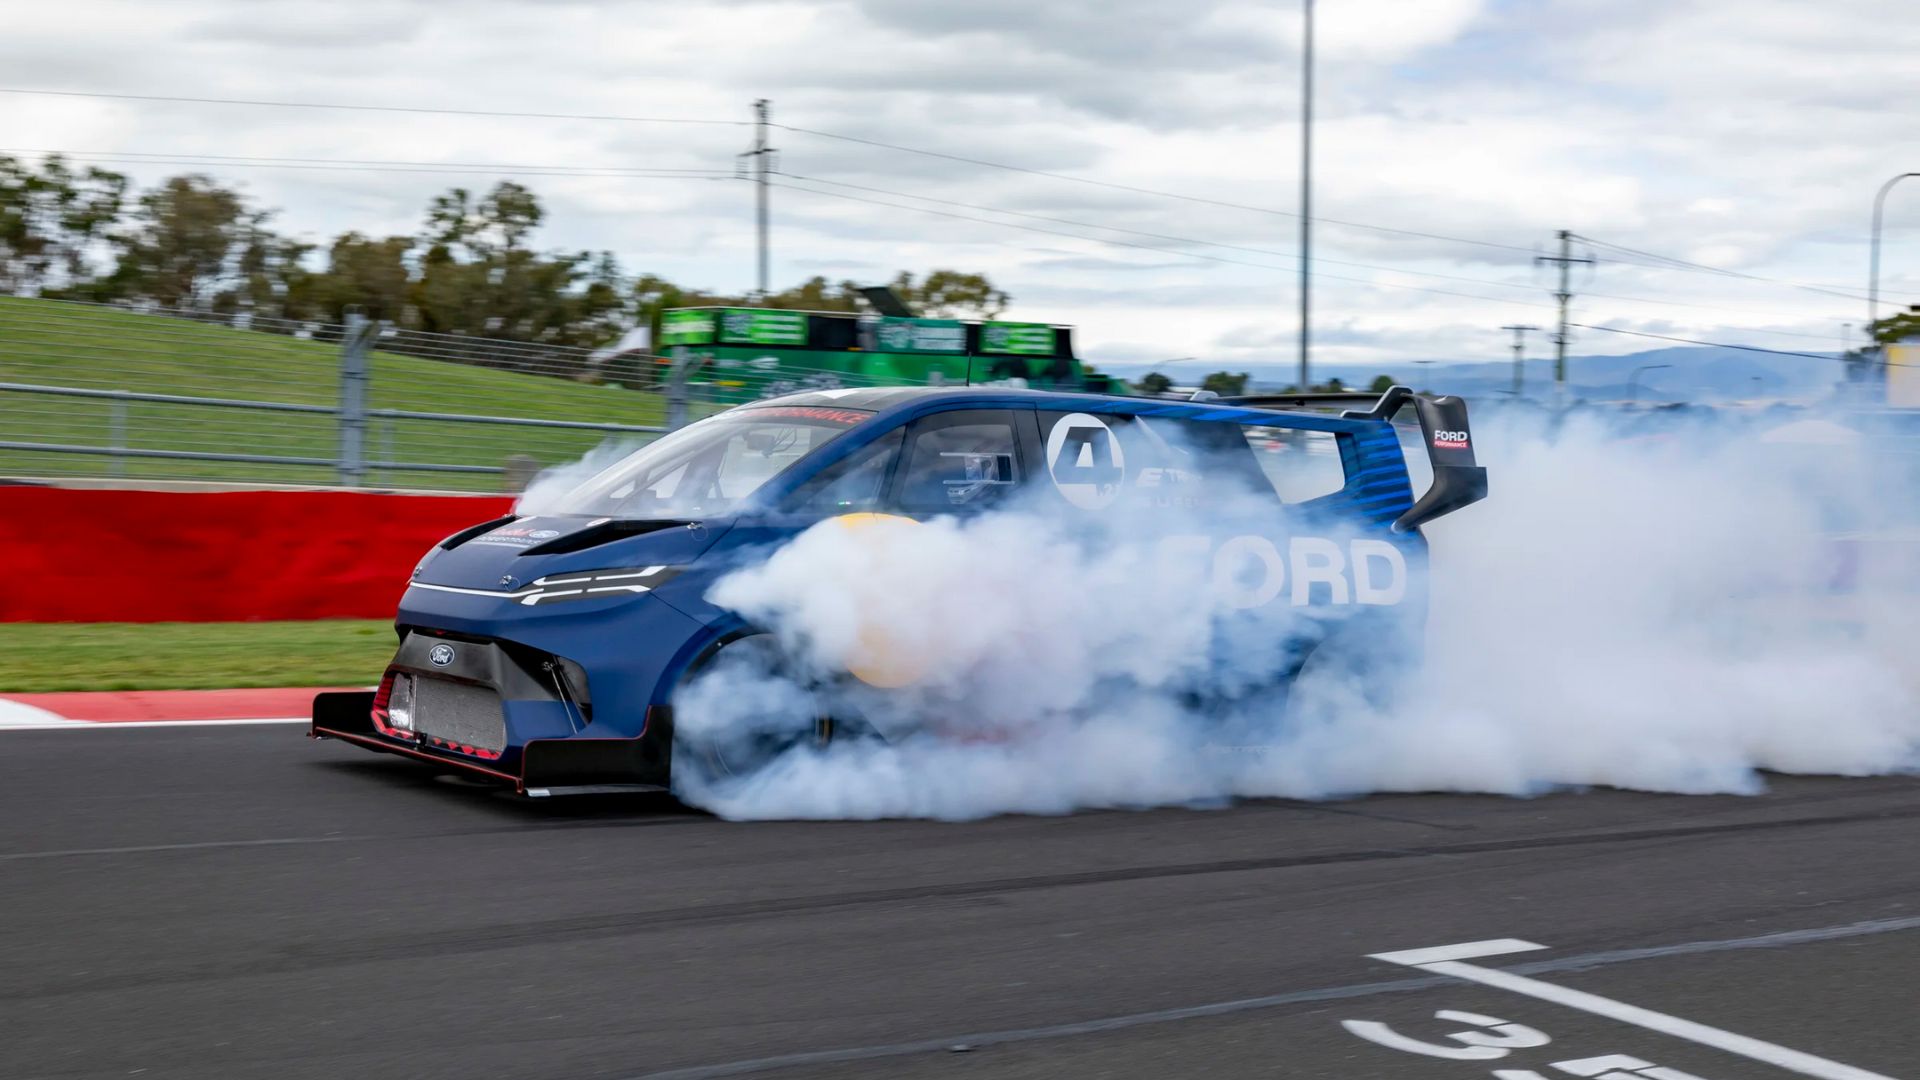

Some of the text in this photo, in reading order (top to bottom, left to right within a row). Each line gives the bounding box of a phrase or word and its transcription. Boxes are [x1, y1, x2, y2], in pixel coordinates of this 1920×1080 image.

[1434, 430, 1468, 441] FORD
[1159, 535, 1407, 609] FORD
[432, 647, 451, 663] Ford
